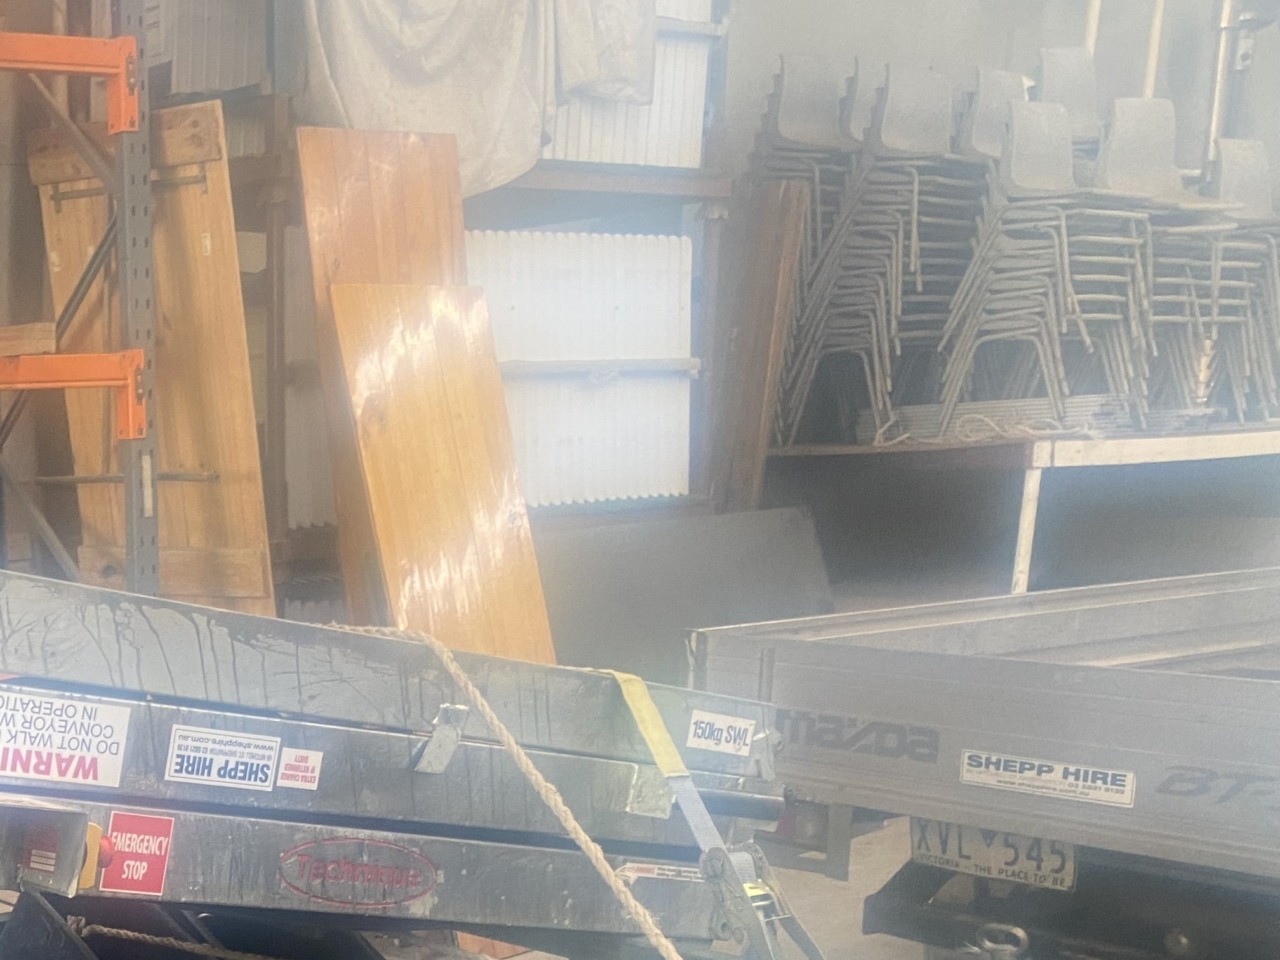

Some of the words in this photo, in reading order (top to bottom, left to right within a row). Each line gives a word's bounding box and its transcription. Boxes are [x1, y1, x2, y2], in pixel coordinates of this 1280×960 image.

[82, 706, 98, 721] IN
[7, 729, 53, 748] WALK
[21, 716, 114, 739] CONVEYOR
[692, 720, 722, 745] 150kg
[725, 725, 749, 747] SWL
[56, 737, 91, 752] NOT
[96, 741, 120, 756] DO
[178, 734, 274, 752] www.shepphire.com.au
[174, 754, 214, 777] HIRE
[217, 760, 271, 783] SHEPP
[966, 754, 1055, 777] SHEPP
[1062, 766, 1127, 788] HIRE
[111, 831, 169, 856] EMERGENCY
[1003, 833, 1067, 875] 545
[121, 860, 148, 881] STOP
[974, 863, 992, 875] THE
[998, 867, 1029, 882] PLACE
[1033, 873, 1047, 884] TO
